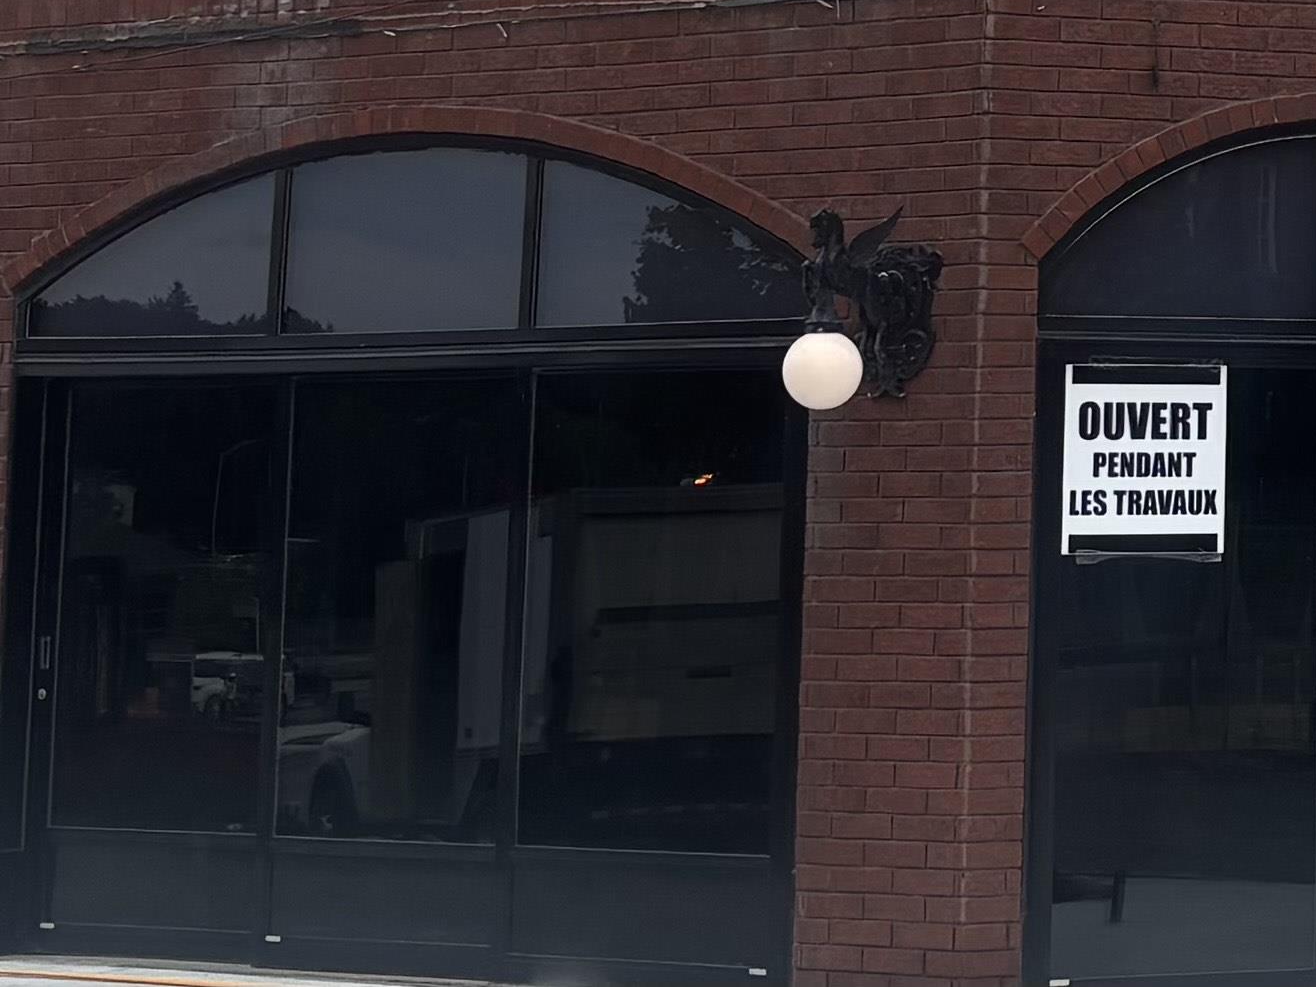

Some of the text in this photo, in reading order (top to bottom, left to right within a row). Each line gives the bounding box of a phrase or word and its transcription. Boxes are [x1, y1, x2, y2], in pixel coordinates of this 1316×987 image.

[1078, 400, 1213, 441] OUVERT
[1092, 451, 1197, 478] PENDANT
[1069, 489, 1218, 516] LES TRAVAUX
